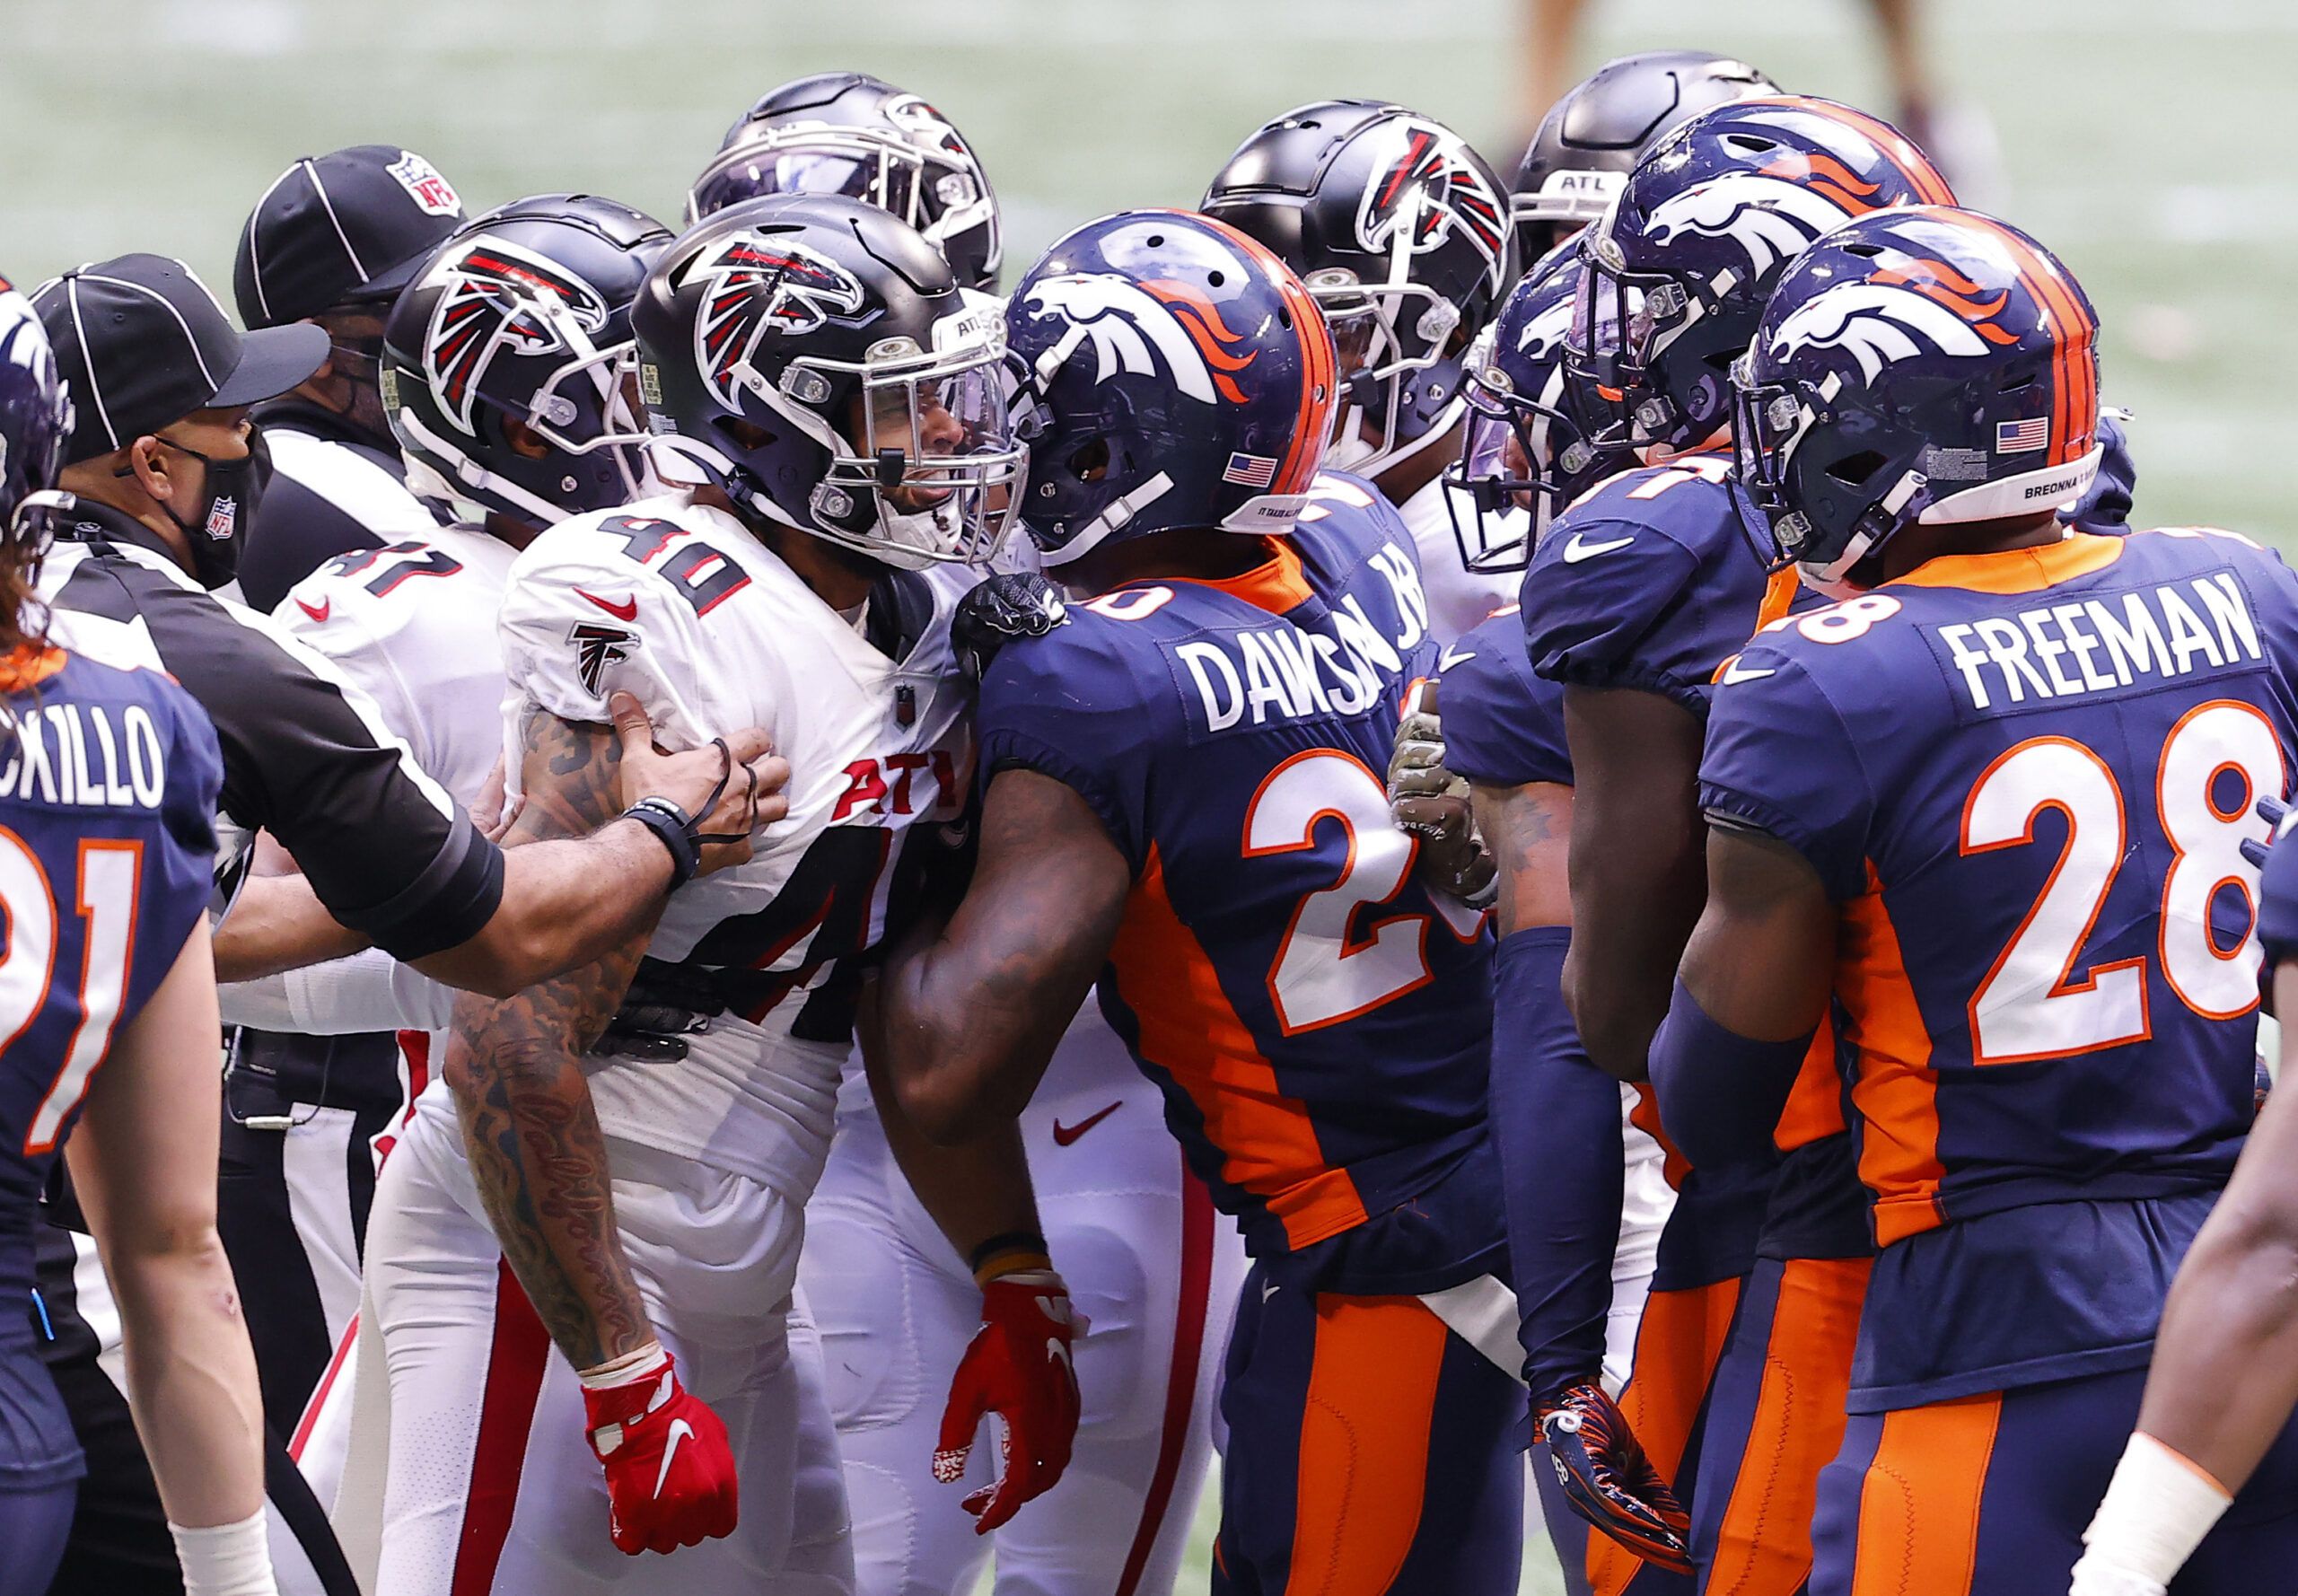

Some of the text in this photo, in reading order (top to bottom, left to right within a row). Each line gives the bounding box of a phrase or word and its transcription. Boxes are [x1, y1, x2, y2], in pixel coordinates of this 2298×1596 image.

[1561, 176, 1606, 191] ATL
[2024, 477, 2078, 499] BREONNA
[209, 513, 232, 535] NFL
[1936, 572, 2264, 710] FREEMAN
[1958, 697, 2288, 1067] 28
